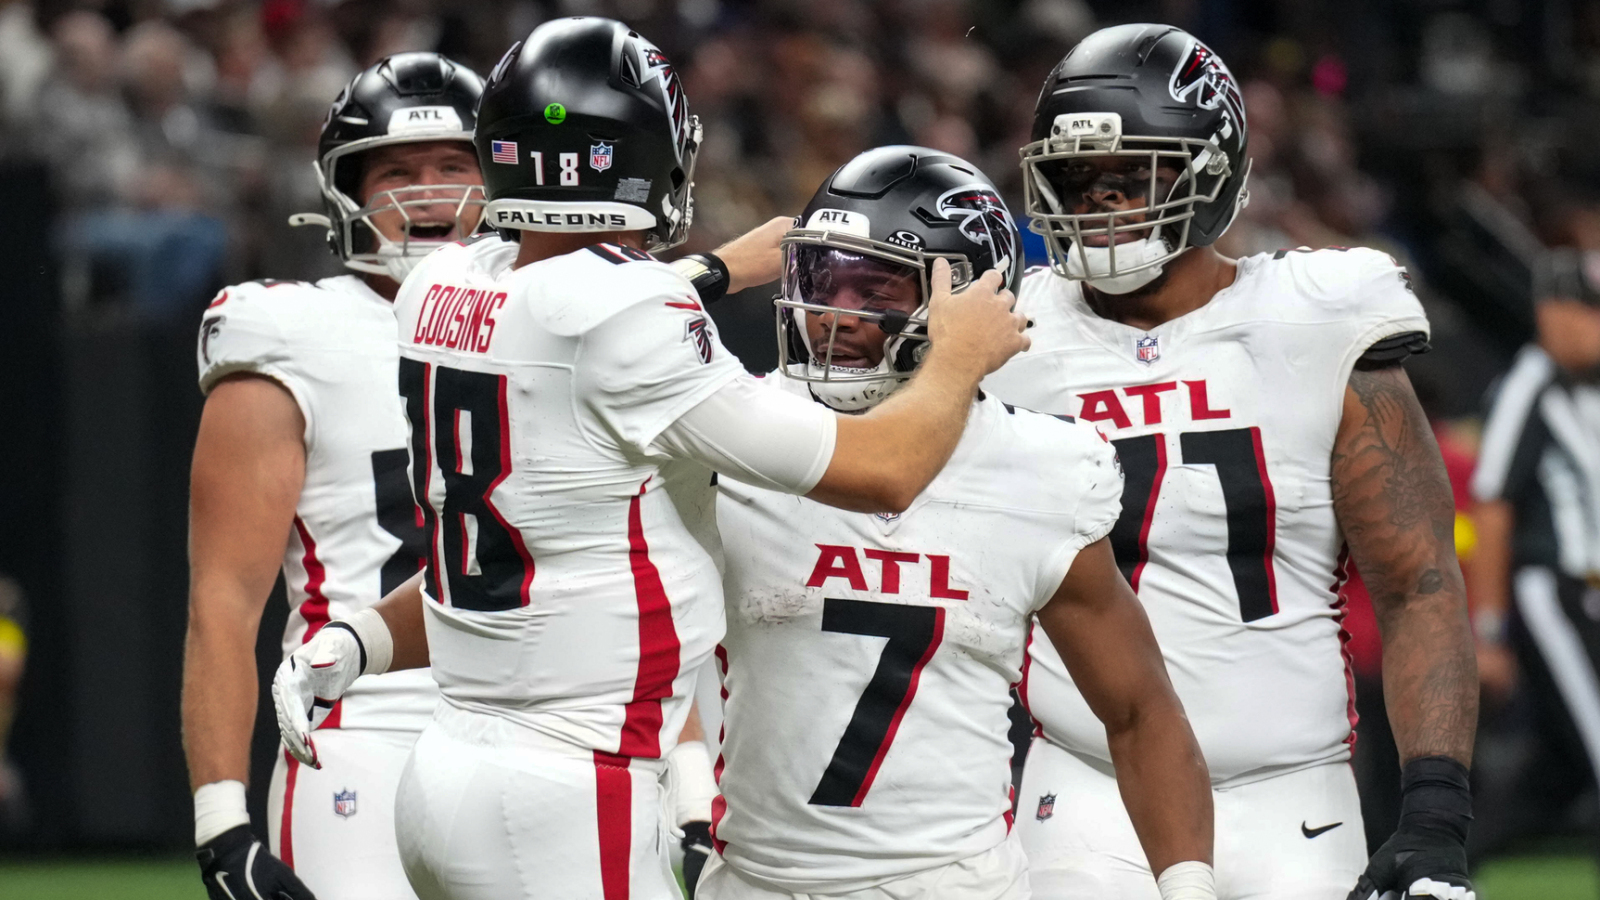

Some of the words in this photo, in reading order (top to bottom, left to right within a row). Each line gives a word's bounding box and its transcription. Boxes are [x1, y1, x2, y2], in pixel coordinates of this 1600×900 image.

[408, 109, 443, 121] ATL
[1072, 119, 1094, 129] ATL
[593, 155, 610, 167] NFL
[496, 211, 627, 227] FALCONS
[818, 211, 850, 224] ATL
[888, 236, 924, 251] OAKLEY
[413, 284, 508, 353] COUSINS
[1138, 347, 1157, 360] NFL
[1075, 379, 1231, 430] ATL
[399, 356, 535, 612] 18
[805, 543, 970, 601] ATL
[807, 597, 946, 808] 7
